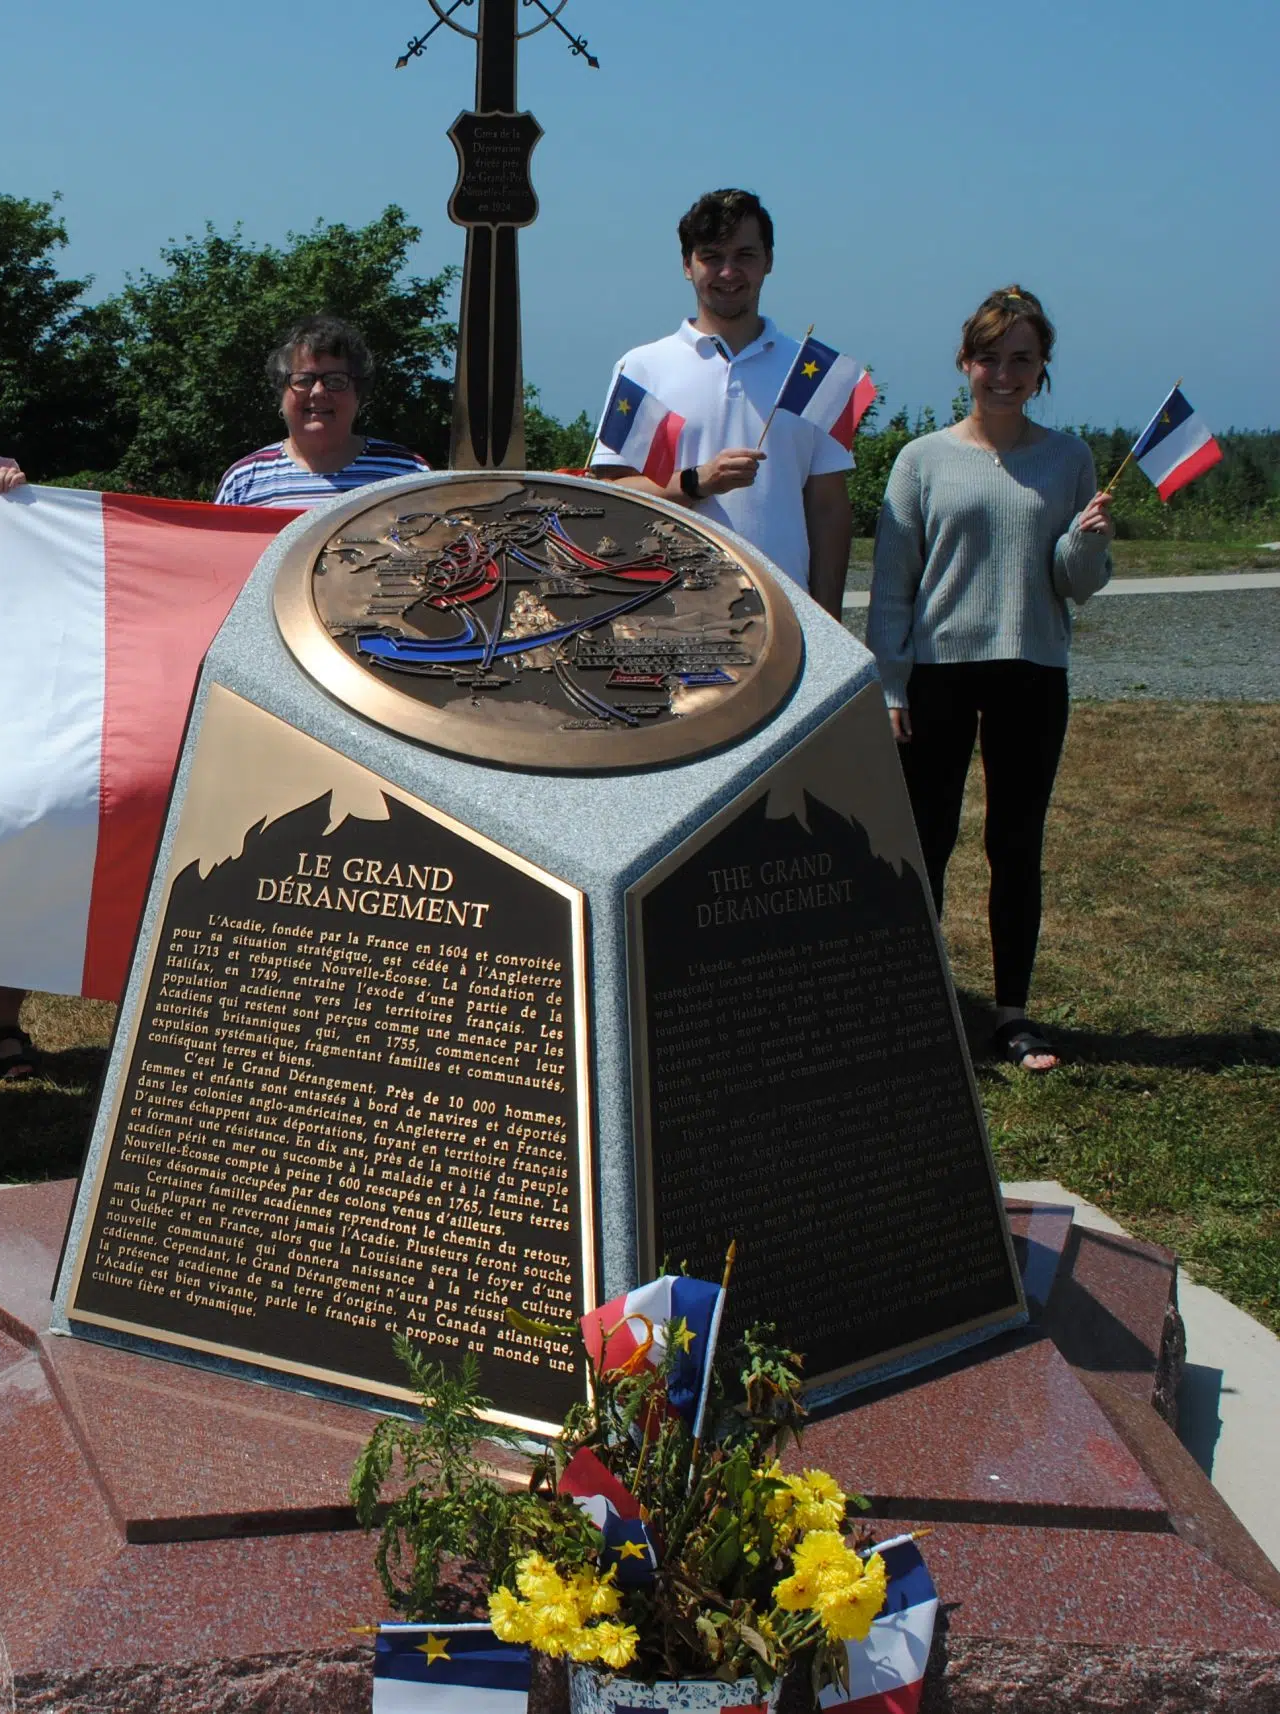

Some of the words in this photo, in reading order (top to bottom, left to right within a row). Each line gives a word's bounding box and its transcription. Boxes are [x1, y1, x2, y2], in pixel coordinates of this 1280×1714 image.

[256, 876, 489, 928] DÉRANGEMENT
[297, 853, 332, 878] LE
[343, 858, 453, 892] GRAND
[696, 878, 853, 928] DÉRANGEMENT
[708, 865, 752, 893] THE
[760, 853, 832, 885] GRAND
[172, 928, 201, 939] pour
[210, 932, 222, 942] sa
[232, 934, 286, 950] situation
[297, 943, 372, 963] stratégique,
[382, 956, 402, 966] est
[412, 958, 449, 973] cédée
[478, 965, 561, 988] l'Angleterre
[208, 914, 265, 933] L'Acadie,
[272, 922, 313, 938] fondée
[319, 931, 341, 943] par
[347, 931, 359, 944] la
[366, 934, 409, 951] France
[416, 944, 431, 954] en
[439, 944, 468, 959] 1604
[475, 951, 488, 961] et
[495, 954, 561, 971] convoitée
[166, 955, 213, 973] Halifax,
[224, 966, 238, 976] en
[251, 967, 281, 983] 1749,
[293, 976, 345, 991] entraîne
[357, 981, 404, 1000] l'exode
[416, 990, 454, 1007] d'une
[466, 1000, 507, 1015] partie
[520, 1005, 537, 1019] de
[549, 1008, 562, 1023] la
[169, 943, 183, 952] en
[193, 944, 219, 957] 1713
[227, 950, 239, 960] et
[249, 952, 311, 970] rebaptisée
[321, 961, 431, 987] Nouvelle-Écosse.
[442, 977, 457, 991] La
[468, 980, 534, 1002] fondation
[545, 991, 562, 1005] de
[719, 972, 752, 988] located
[756, 982, 794, 999] England
[159, 986, 212, 1003] Acadiens
[218, 996, 238, 1008] qui
[244, 1000, 286, 1014] restent
[292, 1008, 319, 1020] sont
[325, 1013, 367, 1027] perçus
[374, 1020, 419, 1035] comme
[426, 1028, 450, 1040] une
[457, 1033, 507, 1048] menace
[513, 1041, 538, 1054] par
[544, 1042, 564, 1057] les
[162, 973, 227, 989] population
[239, 984, 301, 1001] acadienne
[314, 995, 340, 1006] vers
[353, 997, 372, 1011] les
[385, 1004, 452, 1023] territoires
[466, 1014, 524, 1034] français.
[540, 1023, 563, 1040] Les
[152, 1017, 208, 1034] expulsion
[214, 1028, 298, 1050] systématique,
[304, 1039, 382, 1062] fragmentant
[388, 1052, 440, 1071] familles
[447, 1064, 460, 1075] et
[466, 1068, 565, 1093] communautés,
[155, 1003, 208, 1018] autorités
[222, 1010, 300, 1033] britanniques
[315, 1027, 340, 1040] qui,
[355, 1033, 370, 1044] en
[386, 1036, 419, 1053] 1755,
[435, 1046, 520, 1067] commencent
[535, 1058, 565, 1074] leur
[658, 1056, 703, 1075] Acadians
[184, 1051, 215, 1067] C'est
[222, 1057, 234, 1070] le
[242, 1061, 280, 1078] Grand
[288, 1068, 376, 1094] Dérangement.
[386, 1084, 414, 1101] Près
[423, 1091, 439, 1105] de
[448, 1095, 464, 1109] 10
[472, 1099, 496, 1114] 000
[504, 1104, 566, 1128] hommes,
[135, 1089, 183, 1108] D'autres
[189, 1100, 250, 1120] échappent
[255, 1114, 277, 1126] aux
[283, 1116, 367, 1144] déportations,
[373, 1132, 416, 1151] fuyant
[422, 1144, 437, 1154] en
[444, 1146, 506, 1167] territoire
[512, 1157, 568, 1179] français
[147, 1170, 202, 1191] Certaines
[209, 1182, 257, 1202] familles
[263, 1196, 332, 1218] acadiennes
[338, 1211, 417, 1235] reprendront
[423, 1225, 436, 1239] le
[442, 1230, 490, 1250] chemin
[498, 1240, 516, 1256] du
[523, 1248, 570, 1267] retour,
[92, 1271, 133, 1287] culture
[138, 1279, 164, 1294] fière
[169, 1289, 180, 1298] et
[186, 1291, 255, 1316] dynamique.
[99, 1238, 109, 1250] la
[118, 1246, 169, 1264] présence
[178, 1259, 238, 1279] acadienne
[247, 1272, 262, 1285] de
[271, 1280, 283, 1289] sa
[294, 1283, 323, 1299] terre
[333, 1291, 396, 1315] d'origine.
[406, 1308, 425, 1322] Au
[436, 1313, 486, 1336] Canada
[497, 1329, 573, 1356] atlantique,
